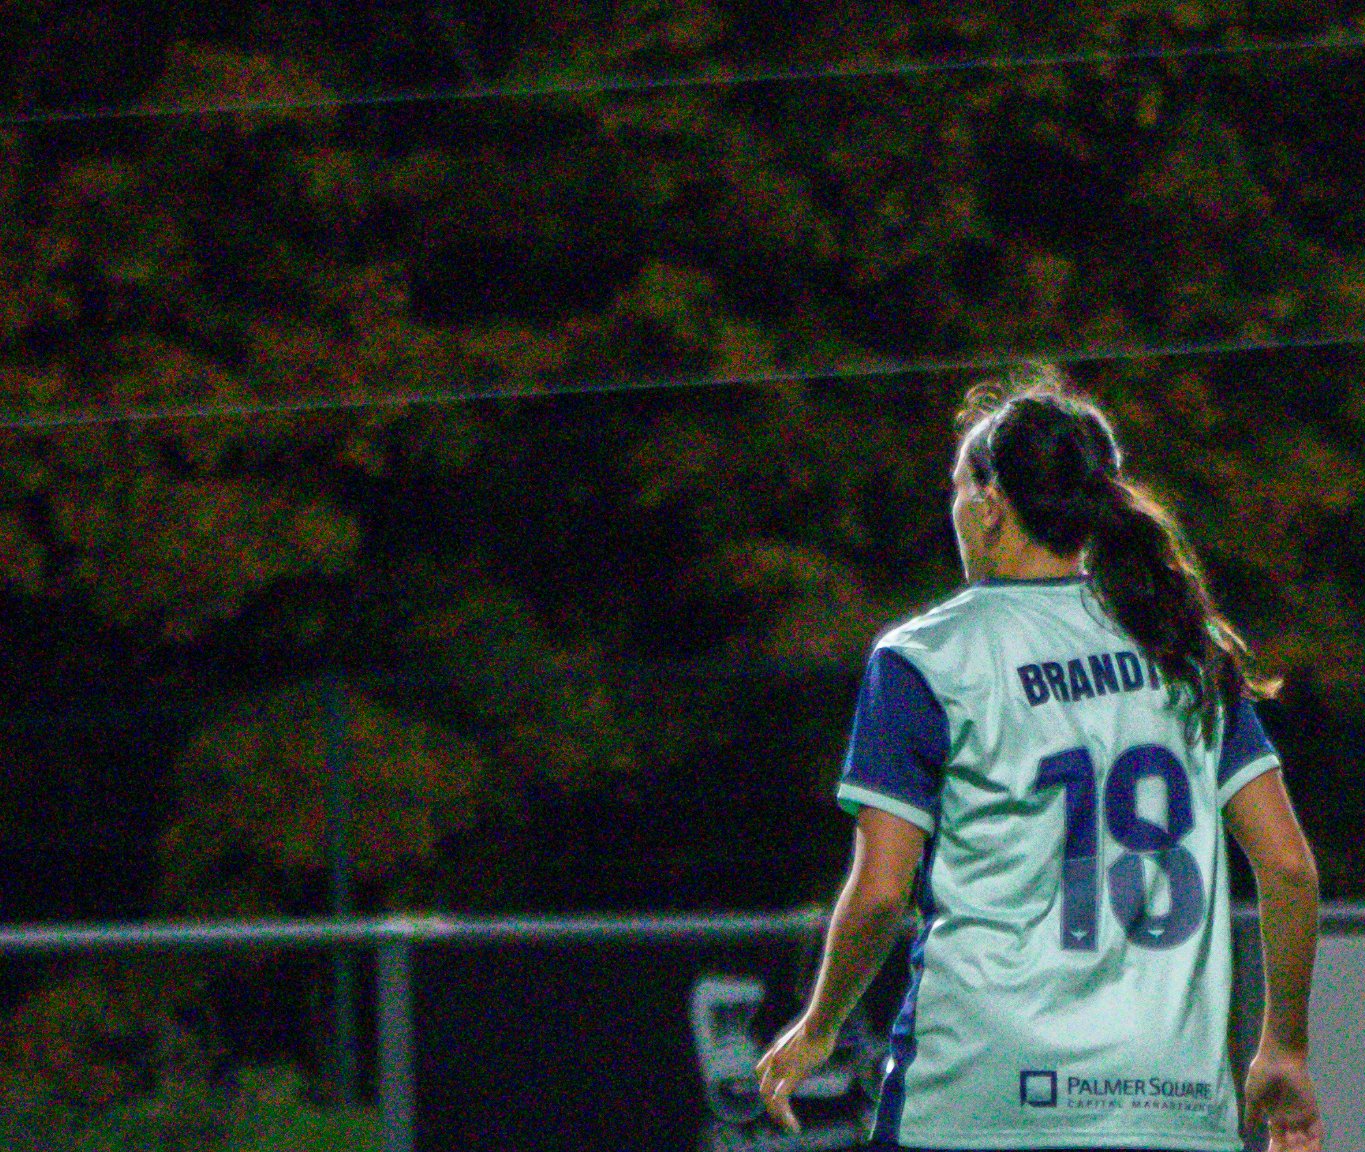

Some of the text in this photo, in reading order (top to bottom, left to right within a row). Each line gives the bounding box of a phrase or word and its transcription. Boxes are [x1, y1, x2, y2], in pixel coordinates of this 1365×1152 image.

[1030, 742, 1207, 953] 18
[1067, 1076, 1212, 1100] PALMER SQUARE
